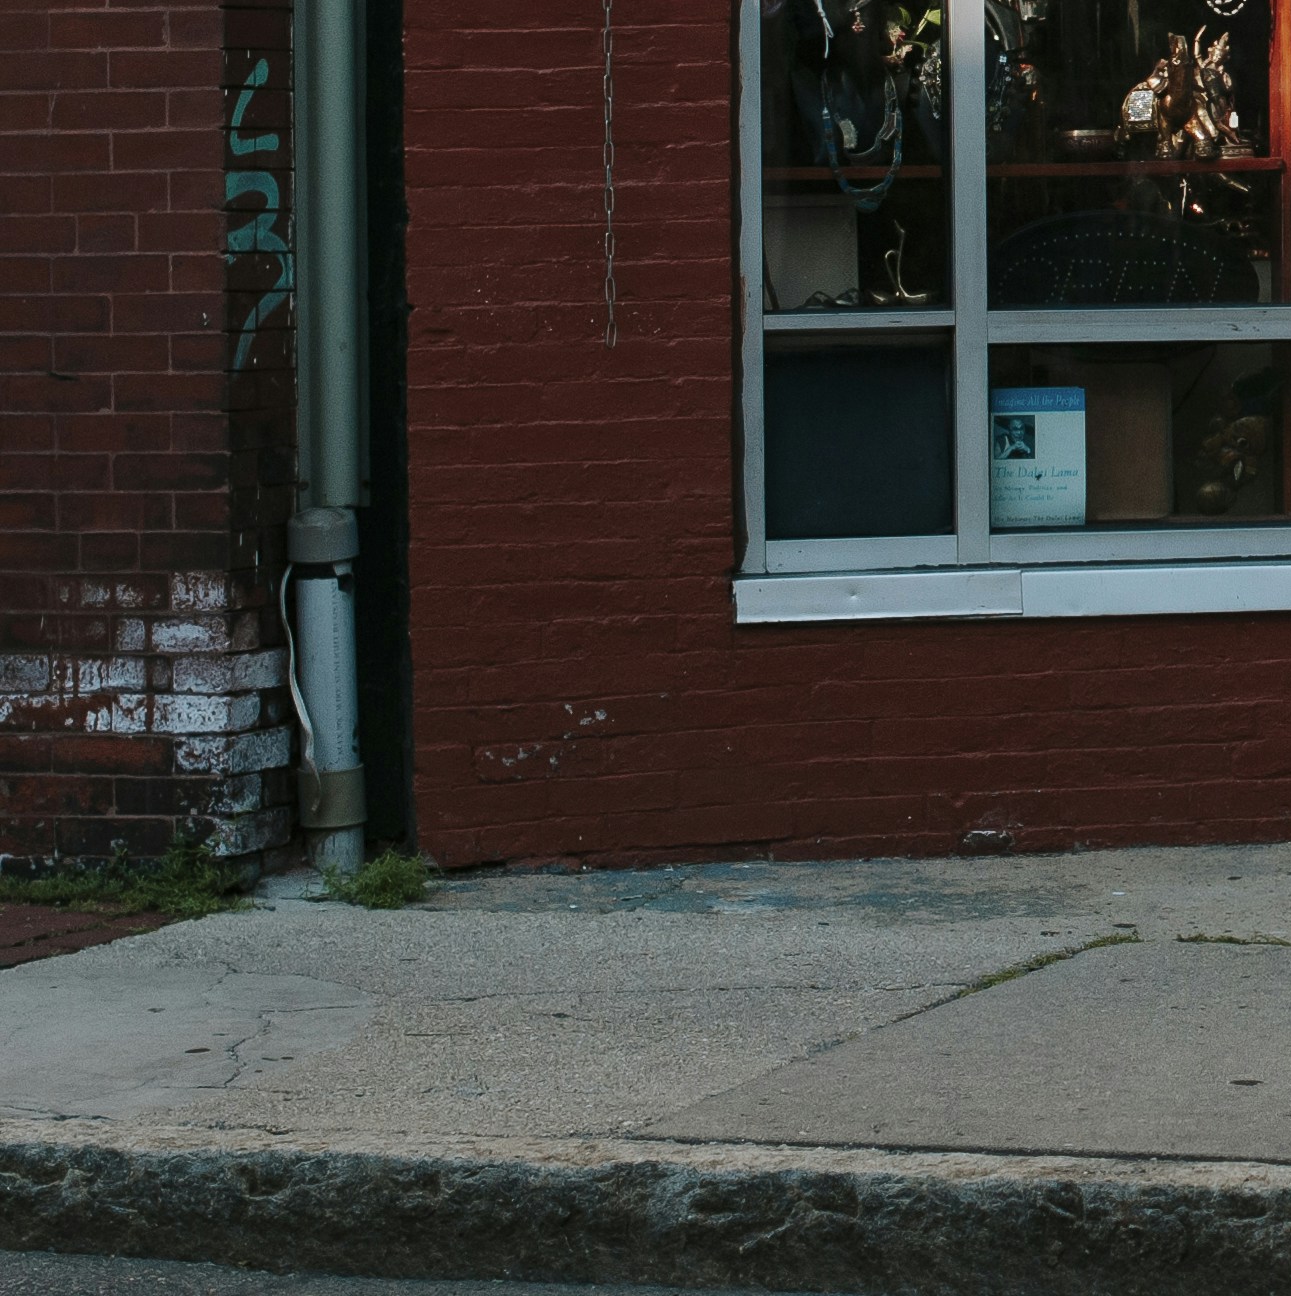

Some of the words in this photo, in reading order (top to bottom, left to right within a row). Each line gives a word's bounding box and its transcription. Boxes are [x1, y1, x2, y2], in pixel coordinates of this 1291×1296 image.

[998, 257, 1224, 303] OPEN
[1028, 396, 1039, 406] All
[1041, 395, 1053, 405] the
[1056, 394, 1080, 407] People
[995, 466, 1014, 477] The
[1018, 466, 1047, 477] Dalai
[1051, 466, 1080, 477] Lama
